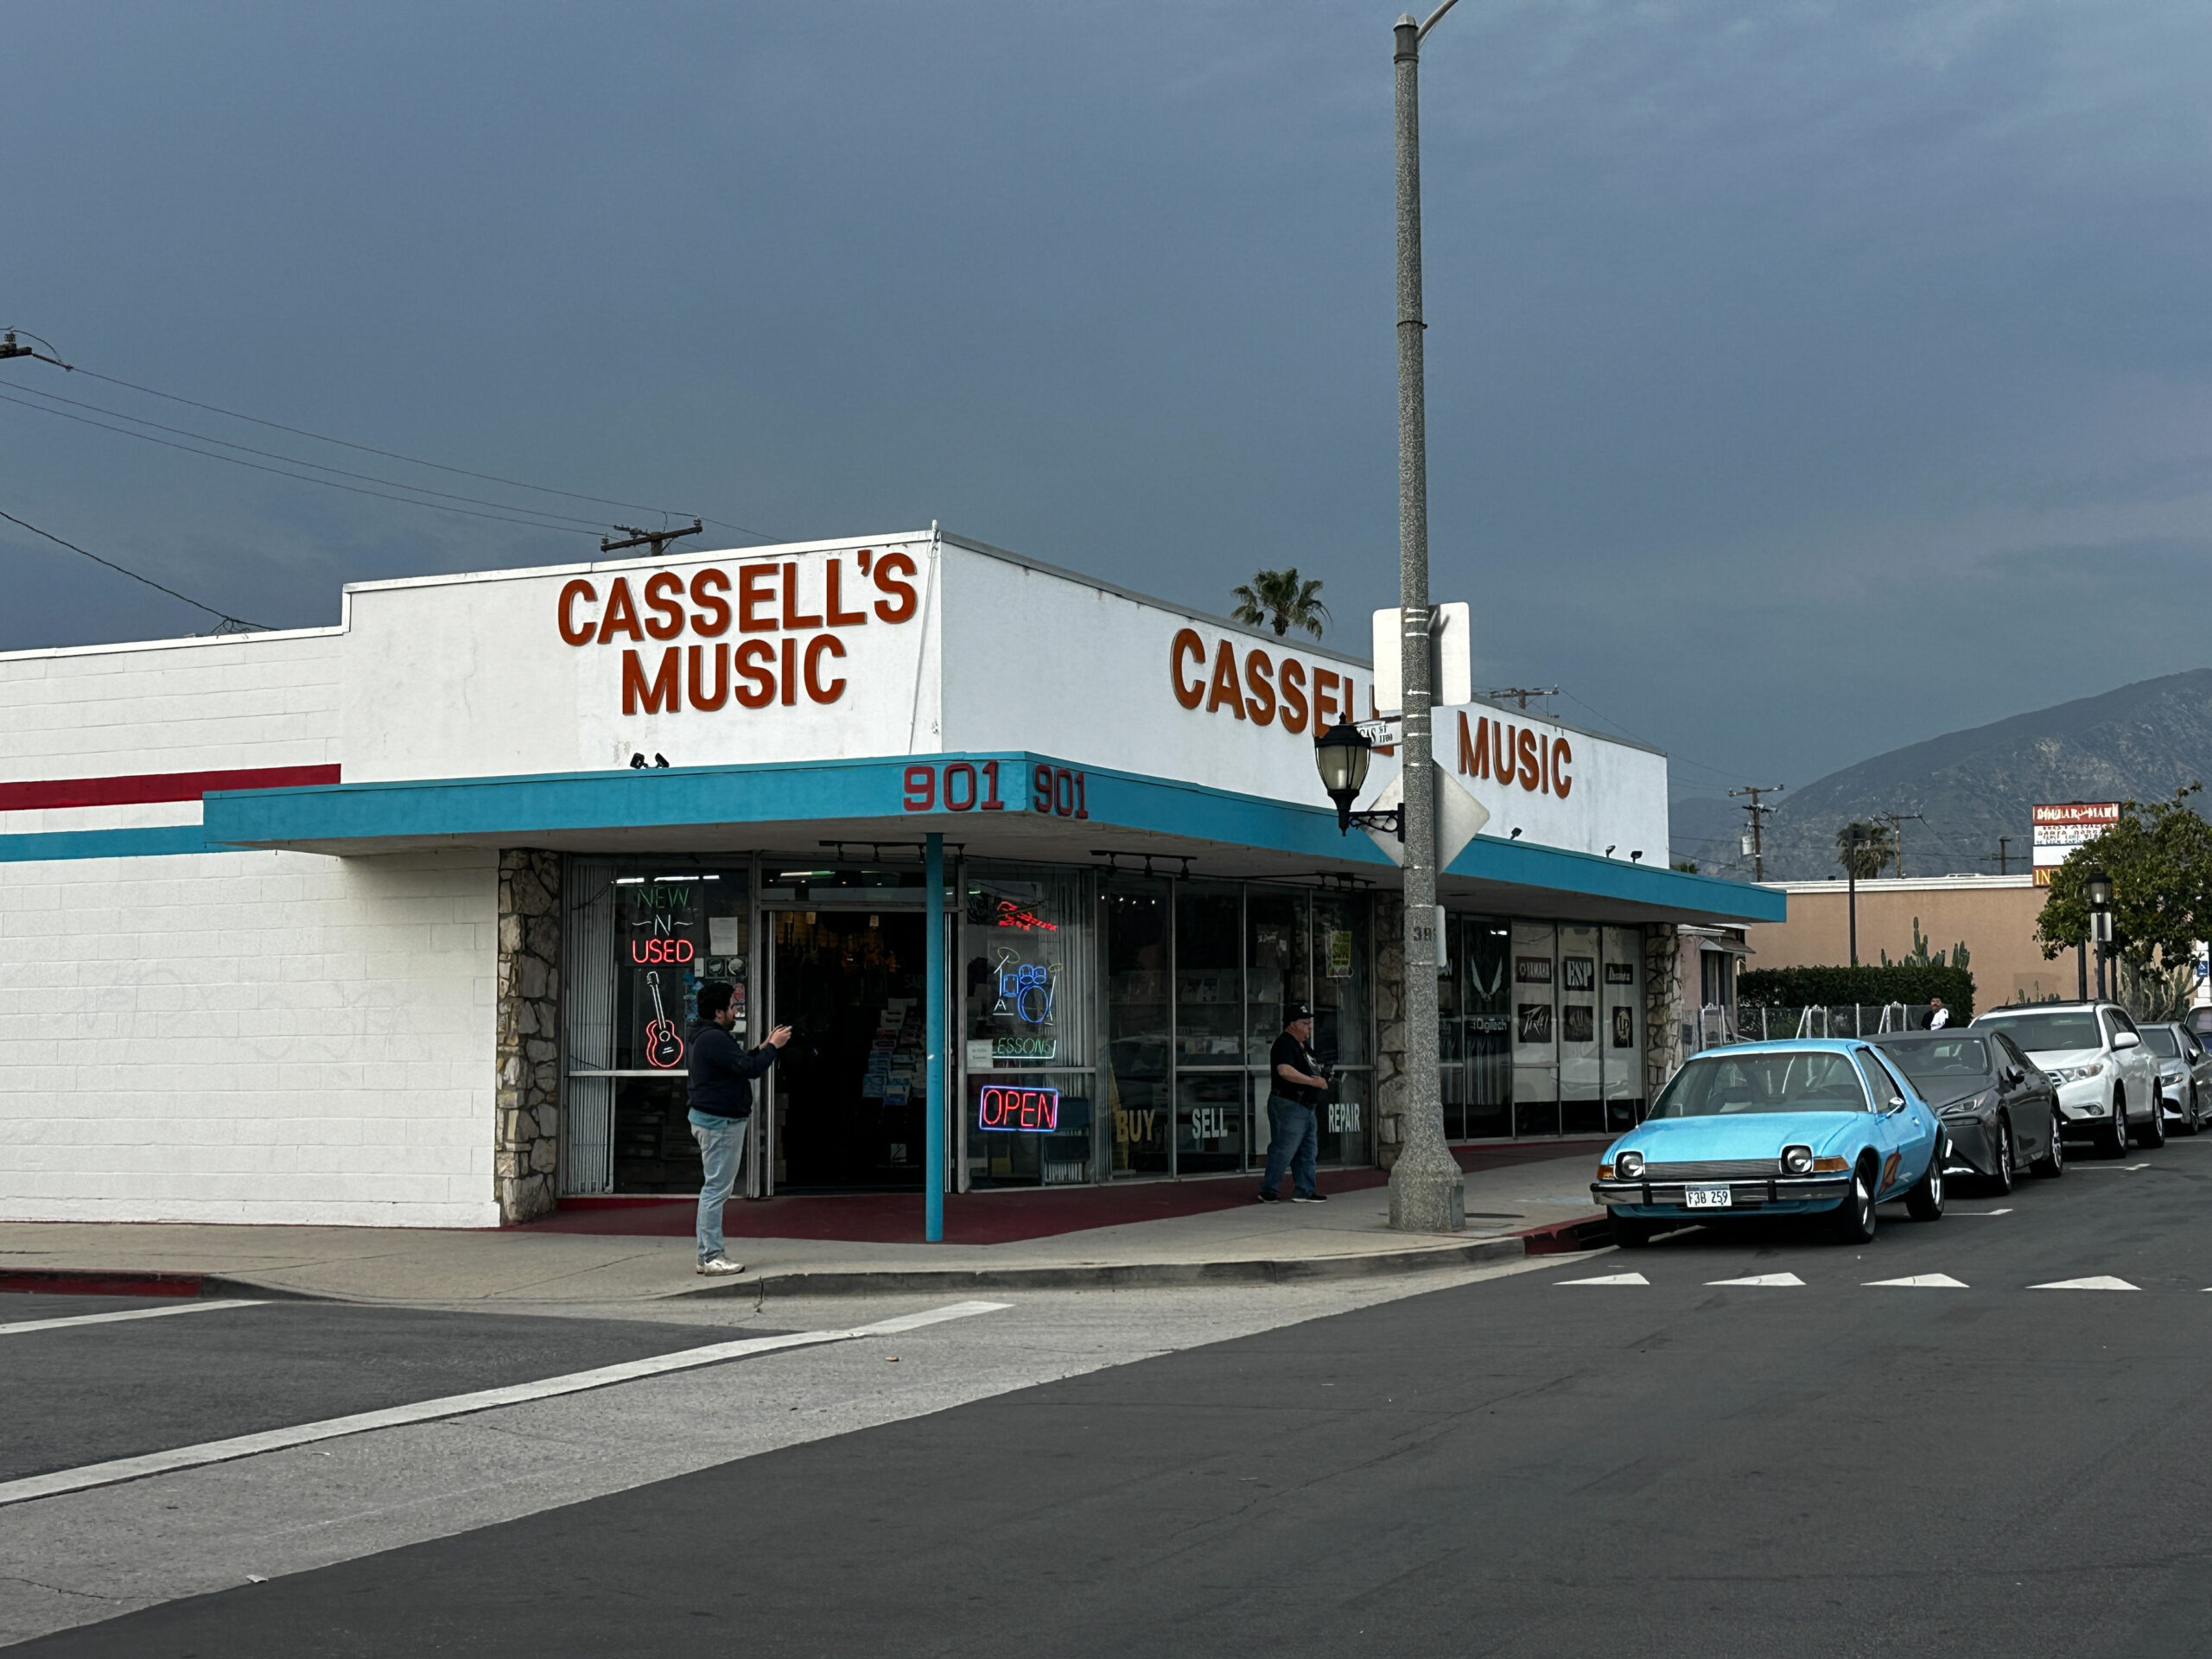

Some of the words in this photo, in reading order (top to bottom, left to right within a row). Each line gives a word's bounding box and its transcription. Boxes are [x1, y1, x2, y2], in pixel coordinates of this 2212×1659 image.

[558, 550, 918, 646] CASSELL'S
[621, 633, 847, 715] MUSIC
[1458, 710, 1572, 799] MUSIC
[904, 760, 1003, 811] 901
[1034, 764, 1089, 819] 901
[637, 887, 690, 907] NEW
[654, 914, 671, 936] N
[632, 938, 695, 964] USED
[1567, 960, 1592, 988] ESP
[982, 1088, 1057, 1129] OPEN
[1192, 1108, 1228, 1140] SELL
[1328, 1103, 1360, 1134] REPAIR
[1116, 1109, 1155, 1142] BUY
